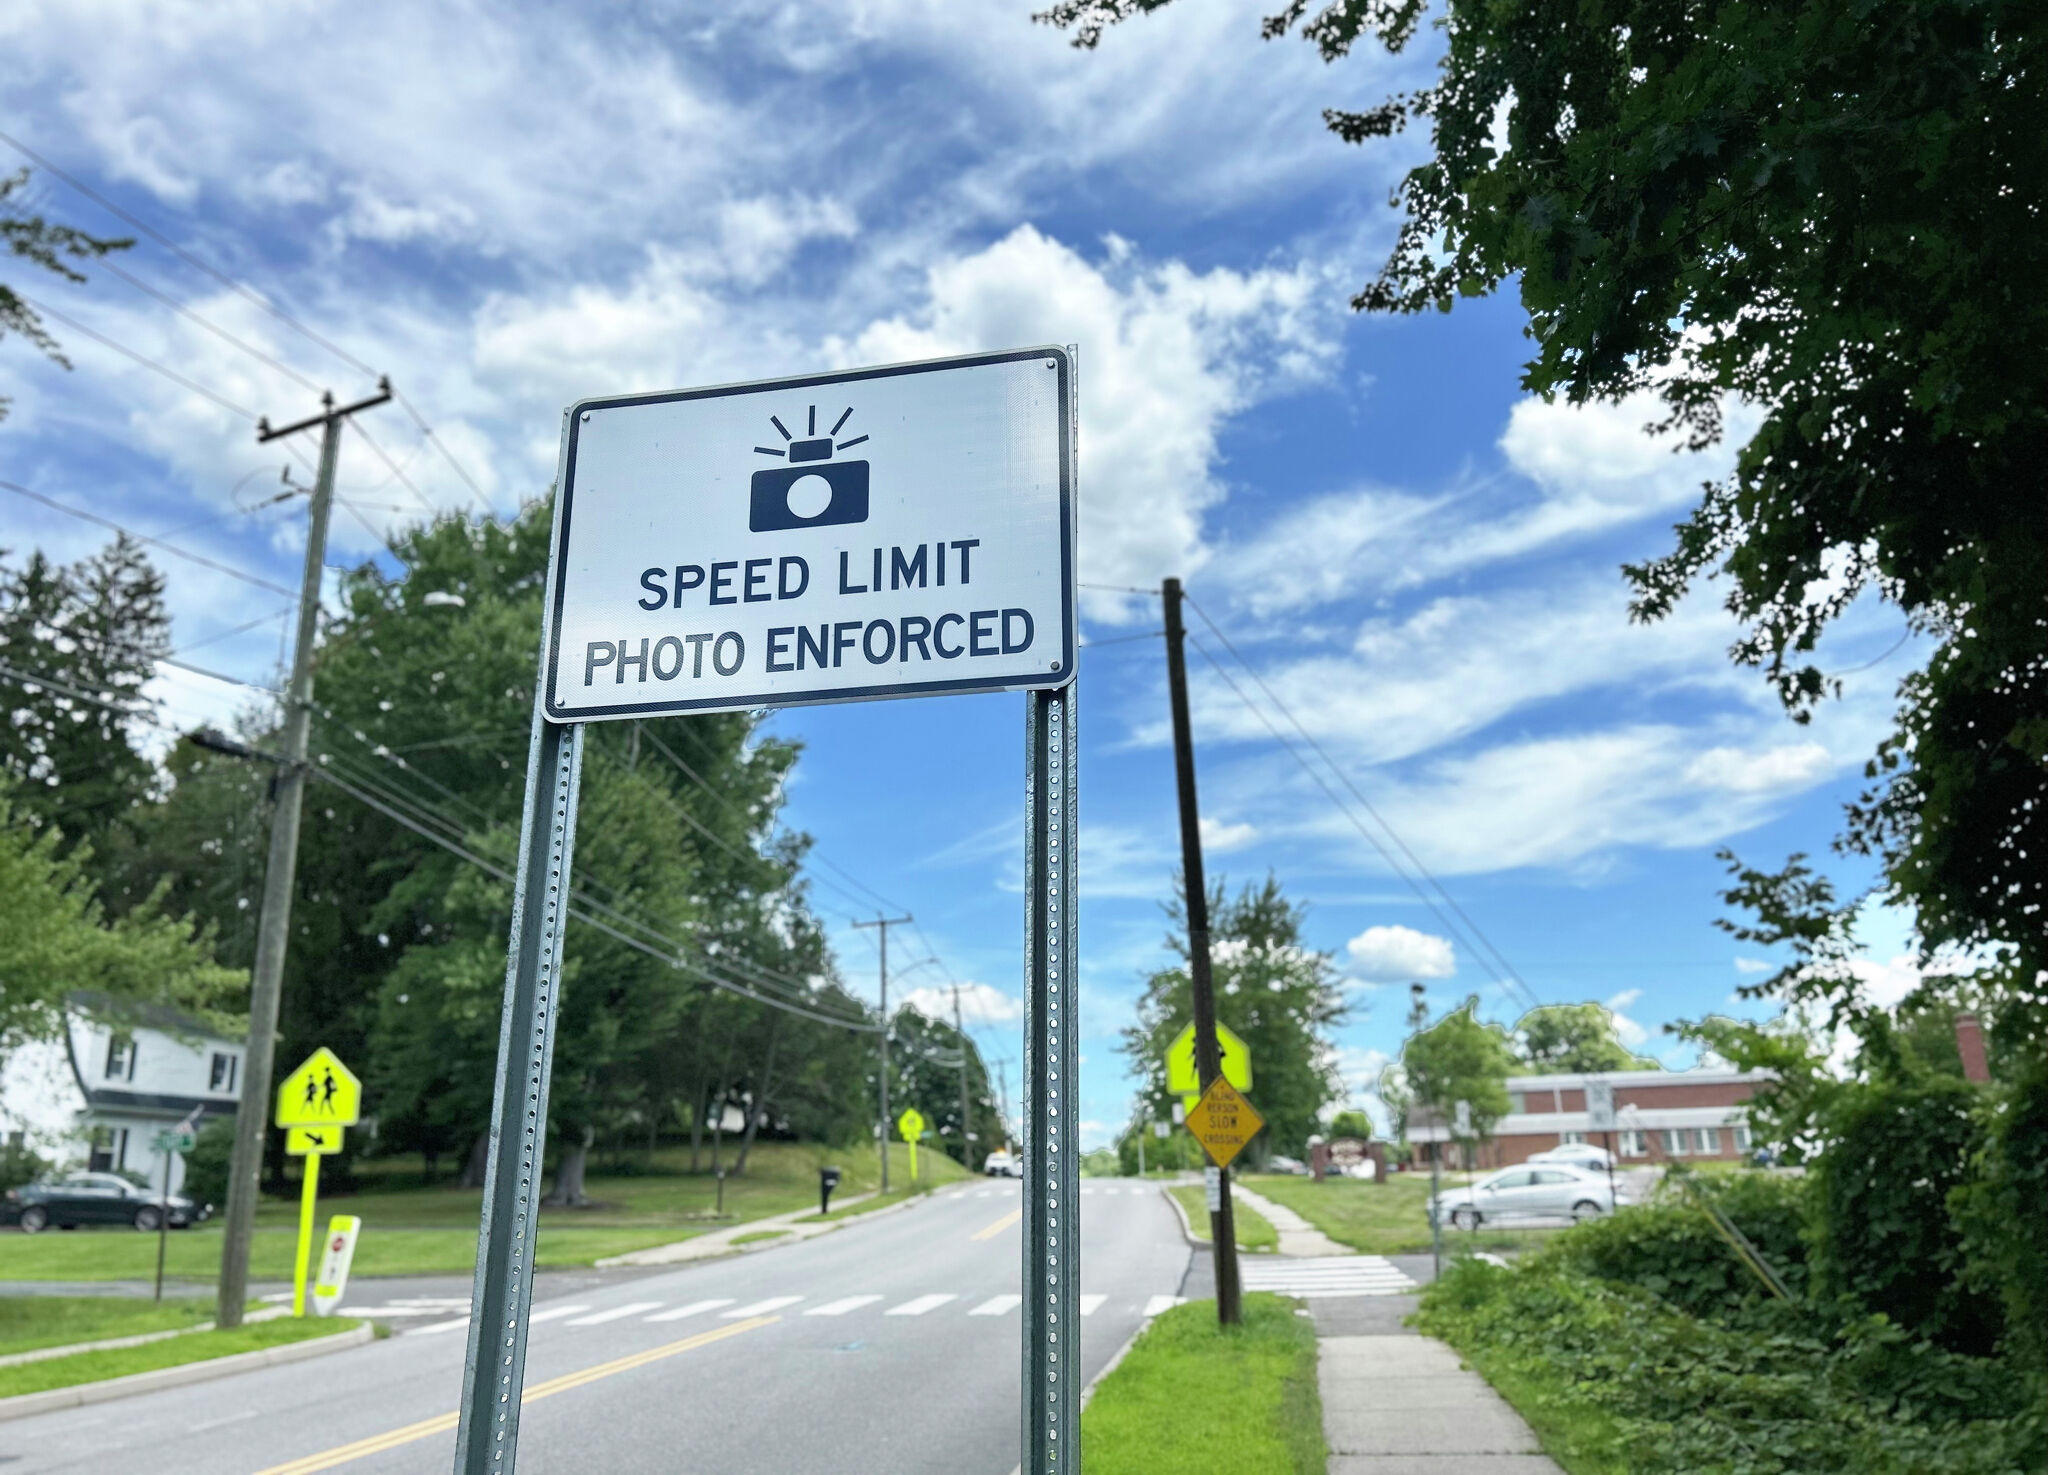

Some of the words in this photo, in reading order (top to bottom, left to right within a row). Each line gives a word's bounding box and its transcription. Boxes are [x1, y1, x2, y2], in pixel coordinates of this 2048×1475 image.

[638, 556, 809, 611] SPEED
[838, 539, 980, 595] LIMIT
[584, 631, 745, 687] PHOTO
[766, 608, 1035, 673] ENFORCED
[1204, 1134, 1244, 1144] CROSSING
[1209, 1116, 1237, 1128] SLOW
